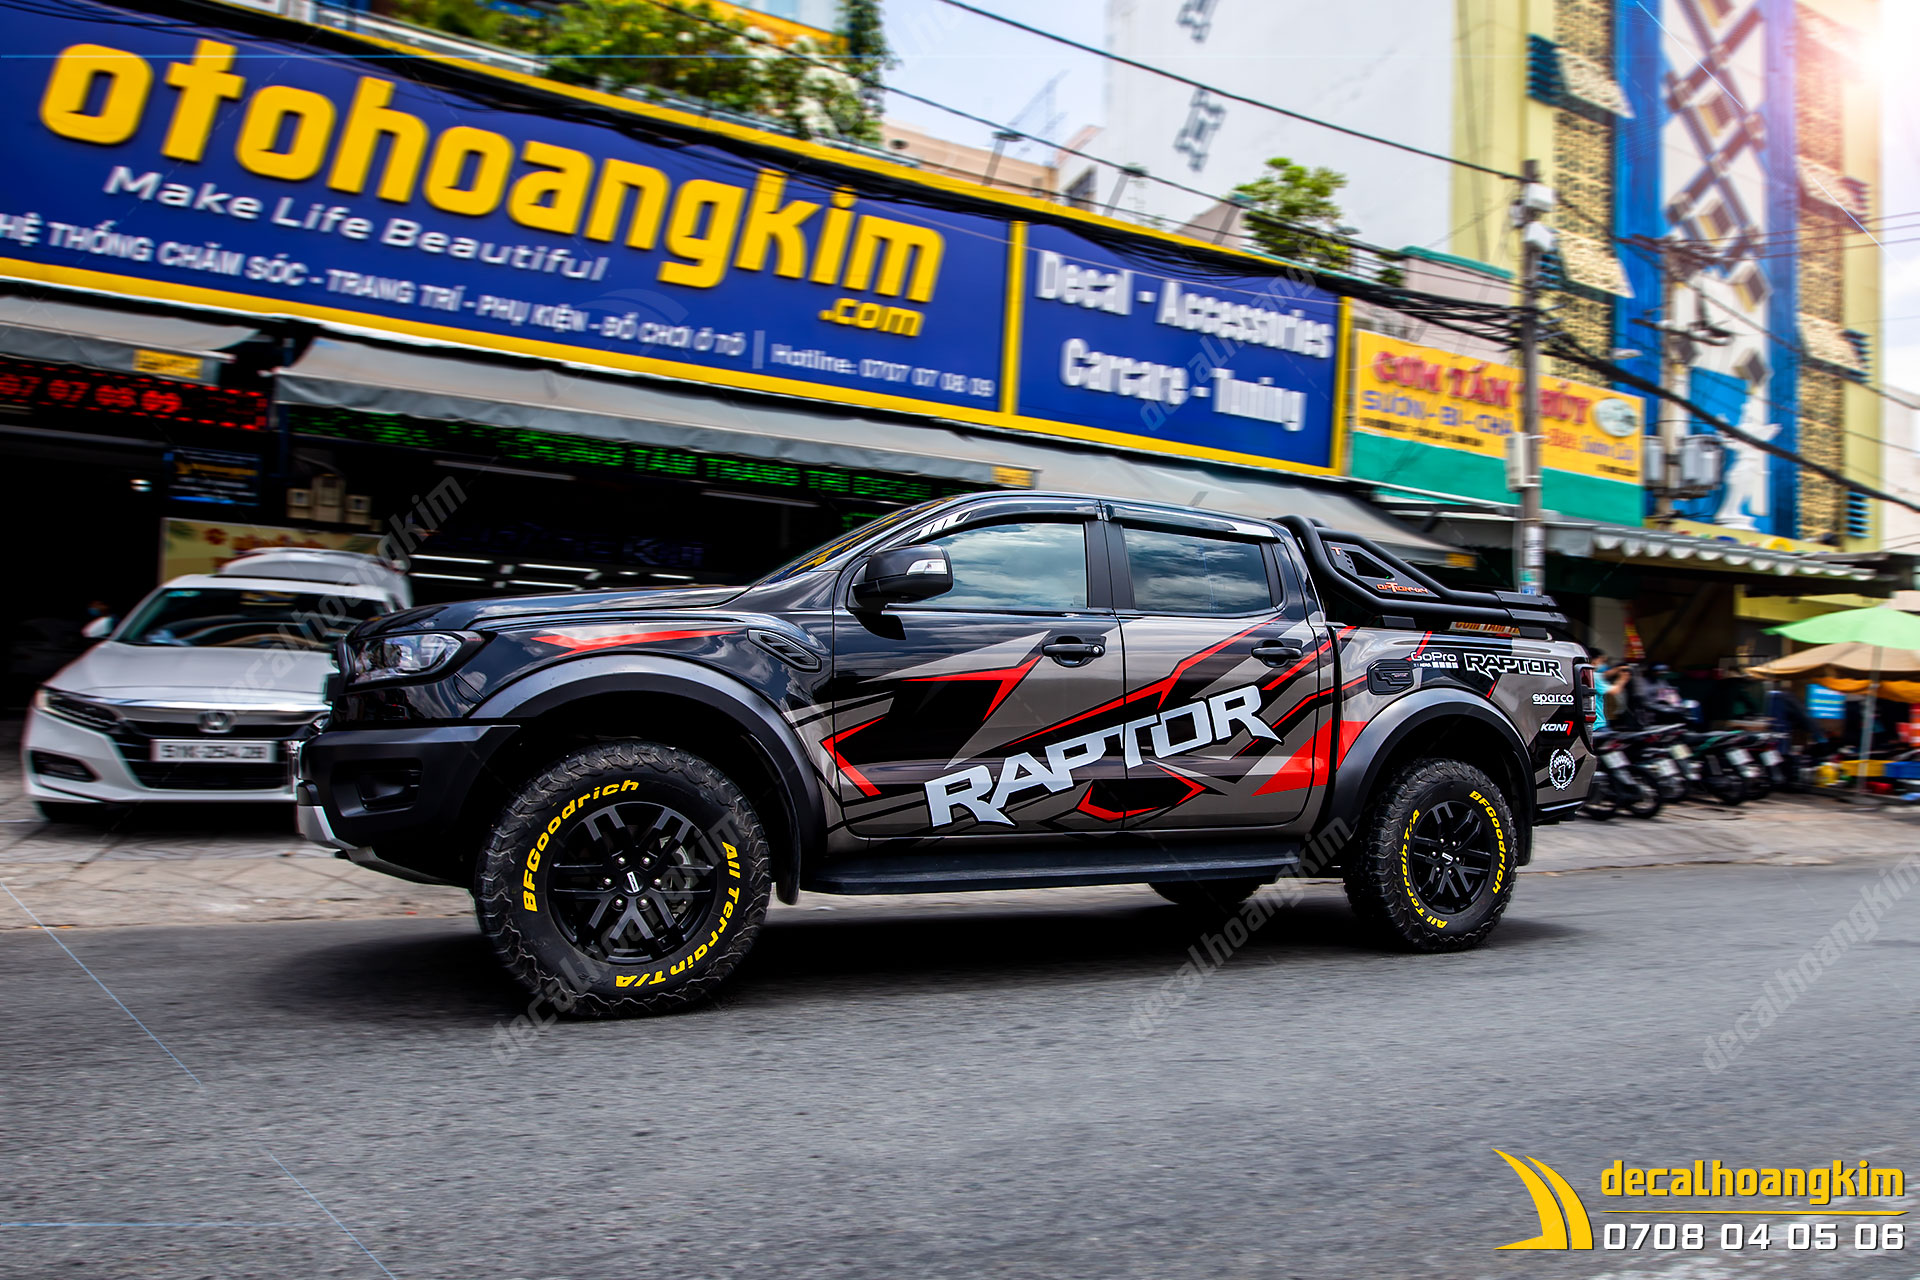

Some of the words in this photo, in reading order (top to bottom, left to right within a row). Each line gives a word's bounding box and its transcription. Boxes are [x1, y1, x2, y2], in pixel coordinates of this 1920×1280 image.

[39, 38, 946, 303] otohoangkim
[103, 166, 262, 219] Make
[271, 196, 374, 240] Life
[380, 218, 610, 282] Beautiful
[326, 269, 416, 304] TRANG
[420, 285, 467, 311] TRÍ
[1035, 249, 1133, 316] Decal
[1156, 278, 1335, 359] Accessories
[1061, 337, 1188, 405] Carcare
[1211, 366, 1308, 431] Tuning
[1410, 651, 1457, 662] GoPro
[1464, 653, 1568, 685] RAPTOR
[924, 685, 1283, 828] RAPTOR
[522, 779, 640, 913] BFGoodrich
[721, 841, 741, 880] All
[1468, 790, 1508, 895] BFGoodrich
[668, 886, 741, 977] Terrain
[1426, 914, 1448, 930] All
[614, 969, 667, 989] T/A
